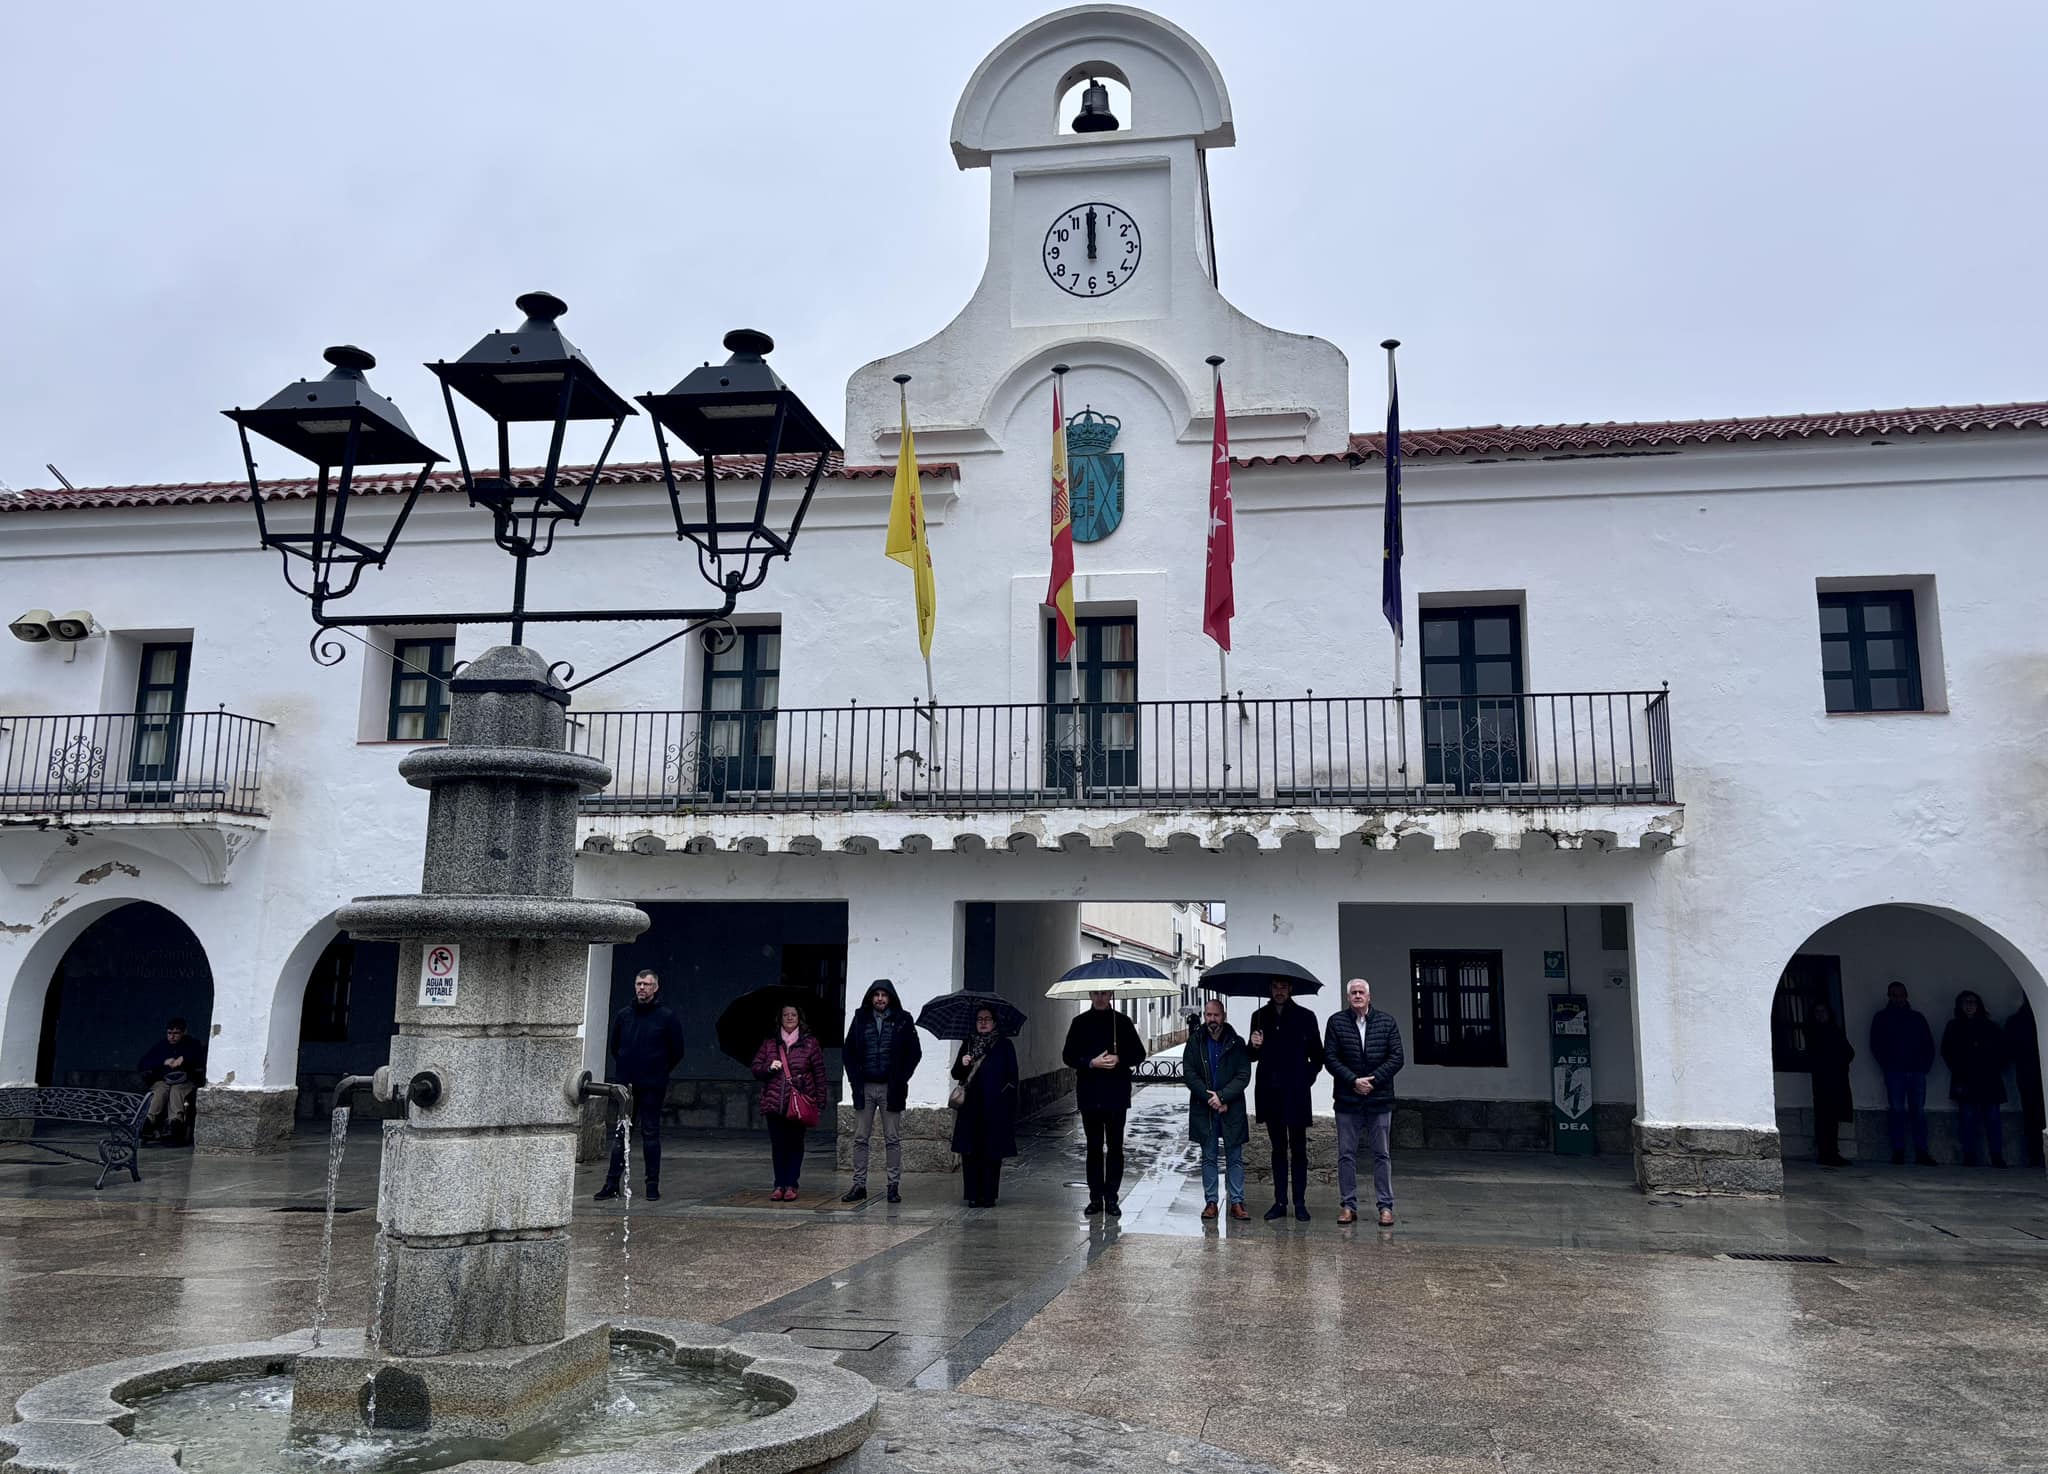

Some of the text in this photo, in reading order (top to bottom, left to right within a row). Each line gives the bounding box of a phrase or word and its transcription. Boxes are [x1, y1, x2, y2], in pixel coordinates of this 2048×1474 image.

[1072, 217, 1080, 230] 11
[1107, 213, 1111, 227] 1
[1057, 229, 1069, 242] 10
[1119, 224, 1128, 237] 2
[1051, 246, 1060, 260] 9
[1125, 240, 1134, 254] 3
[1056, 263, 1065, 277] 8
[1120, 258, 1128, 272] 4
[1071, 273, 1080, 287] 7
[1088, 276, 1097, 289] 6
[1106, 271, 1116, 284] 5
[426, 977, 453, 986] AGUA NO
[425, 986, 453, 996] POTABLE
[1558, 1055, 1587, 1064] AED
[1559, 1122, 1589, 1131] DEA
